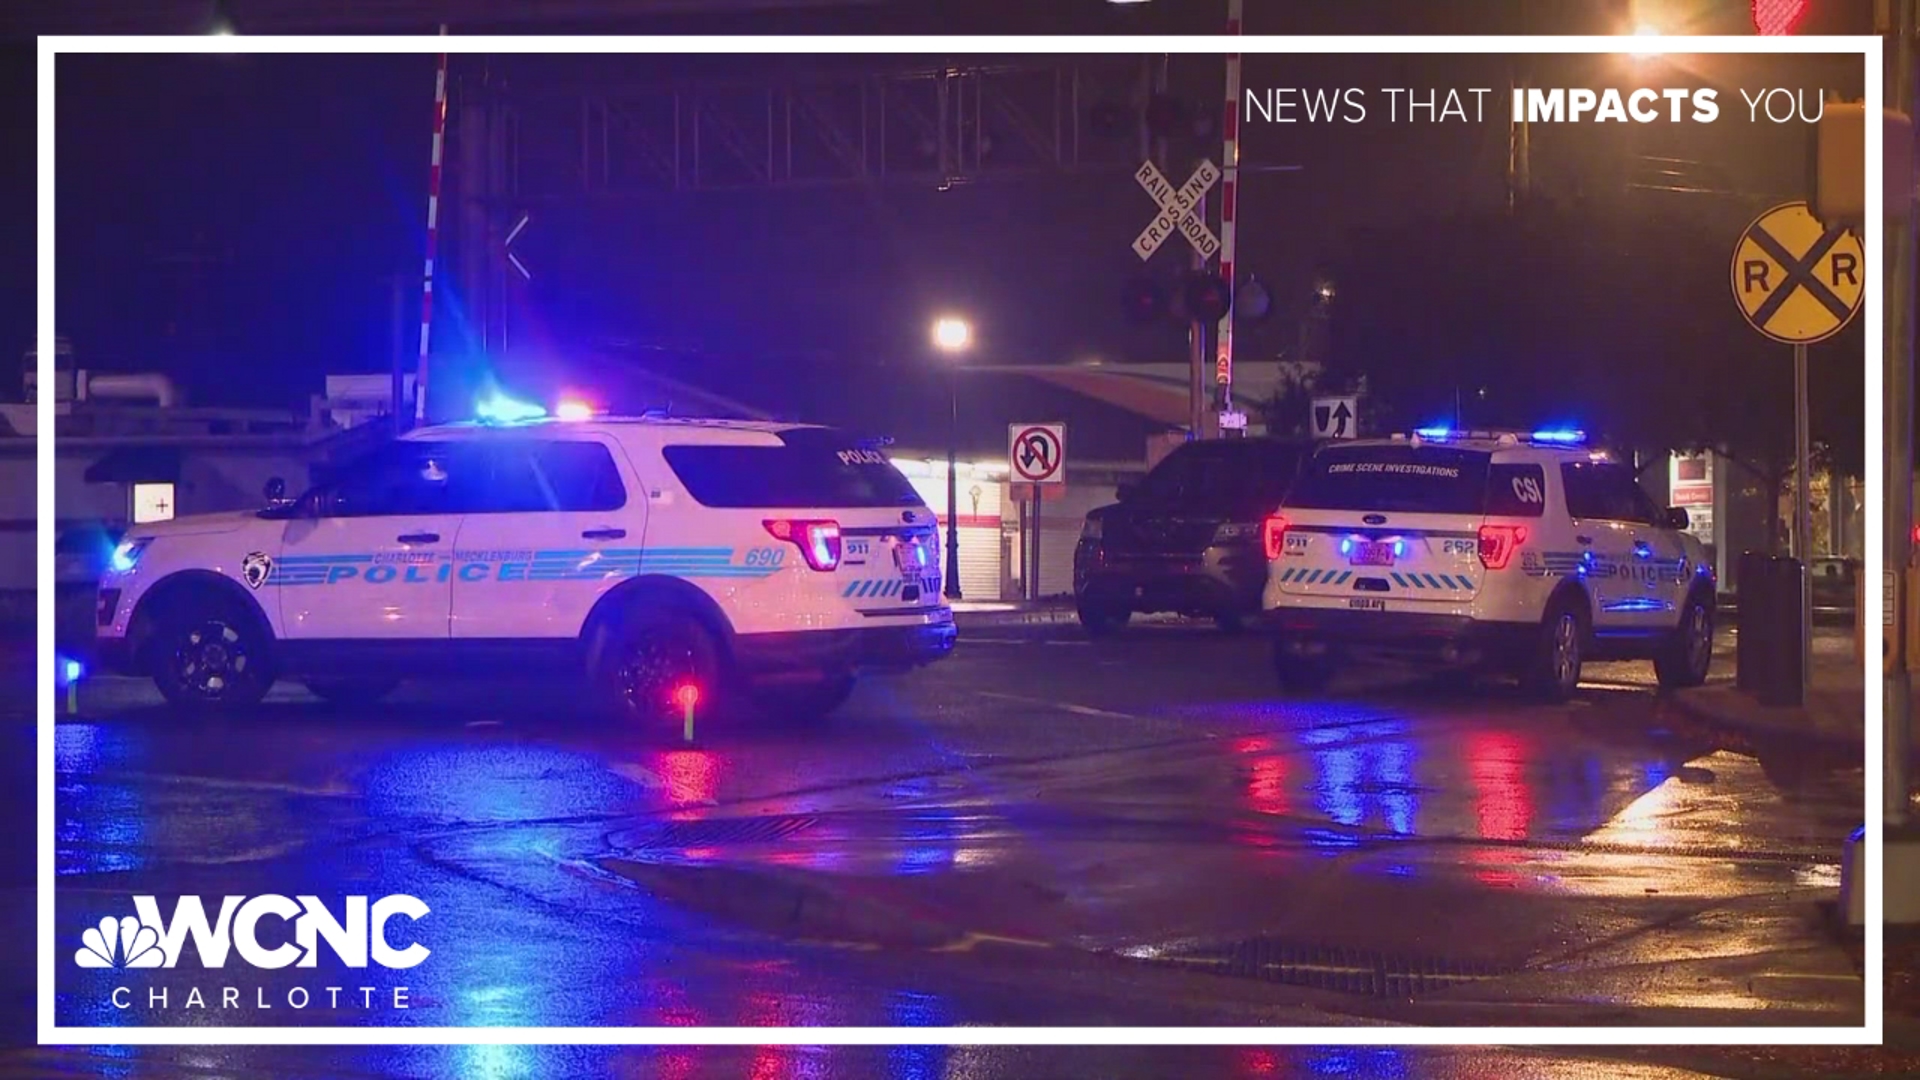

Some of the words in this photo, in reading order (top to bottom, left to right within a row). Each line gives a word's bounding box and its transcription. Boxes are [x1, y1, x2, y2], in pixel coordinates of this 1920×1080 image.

[1139, 166, 1169, 205] RAIL
[1182, 215, 1215, 254] ROAD
[1139, 168, 1213, 252] CROSSING
[1744, 260, 1770, 293] R
[1831, 253, 1858, 287] R
[1328, 464, 1355, 473] CRIME
[1355, 463, 1384, 472] SCENE
[1384, 463, 1459, 478] INVESTIGATIONS
[1511, 476, 1543, 503] CSI
[847, 543, 869, 555] 911
[1286, 538, 1308, 547] 911
[1443, 540, 1475, 554] 262
[374, 551, 435, 564] CHARLOTTE
[454, 550, 533, 562] MECKLENBURG
[744, 549, 785, 566] 690
[326, 562, 529, 584] POLICE
